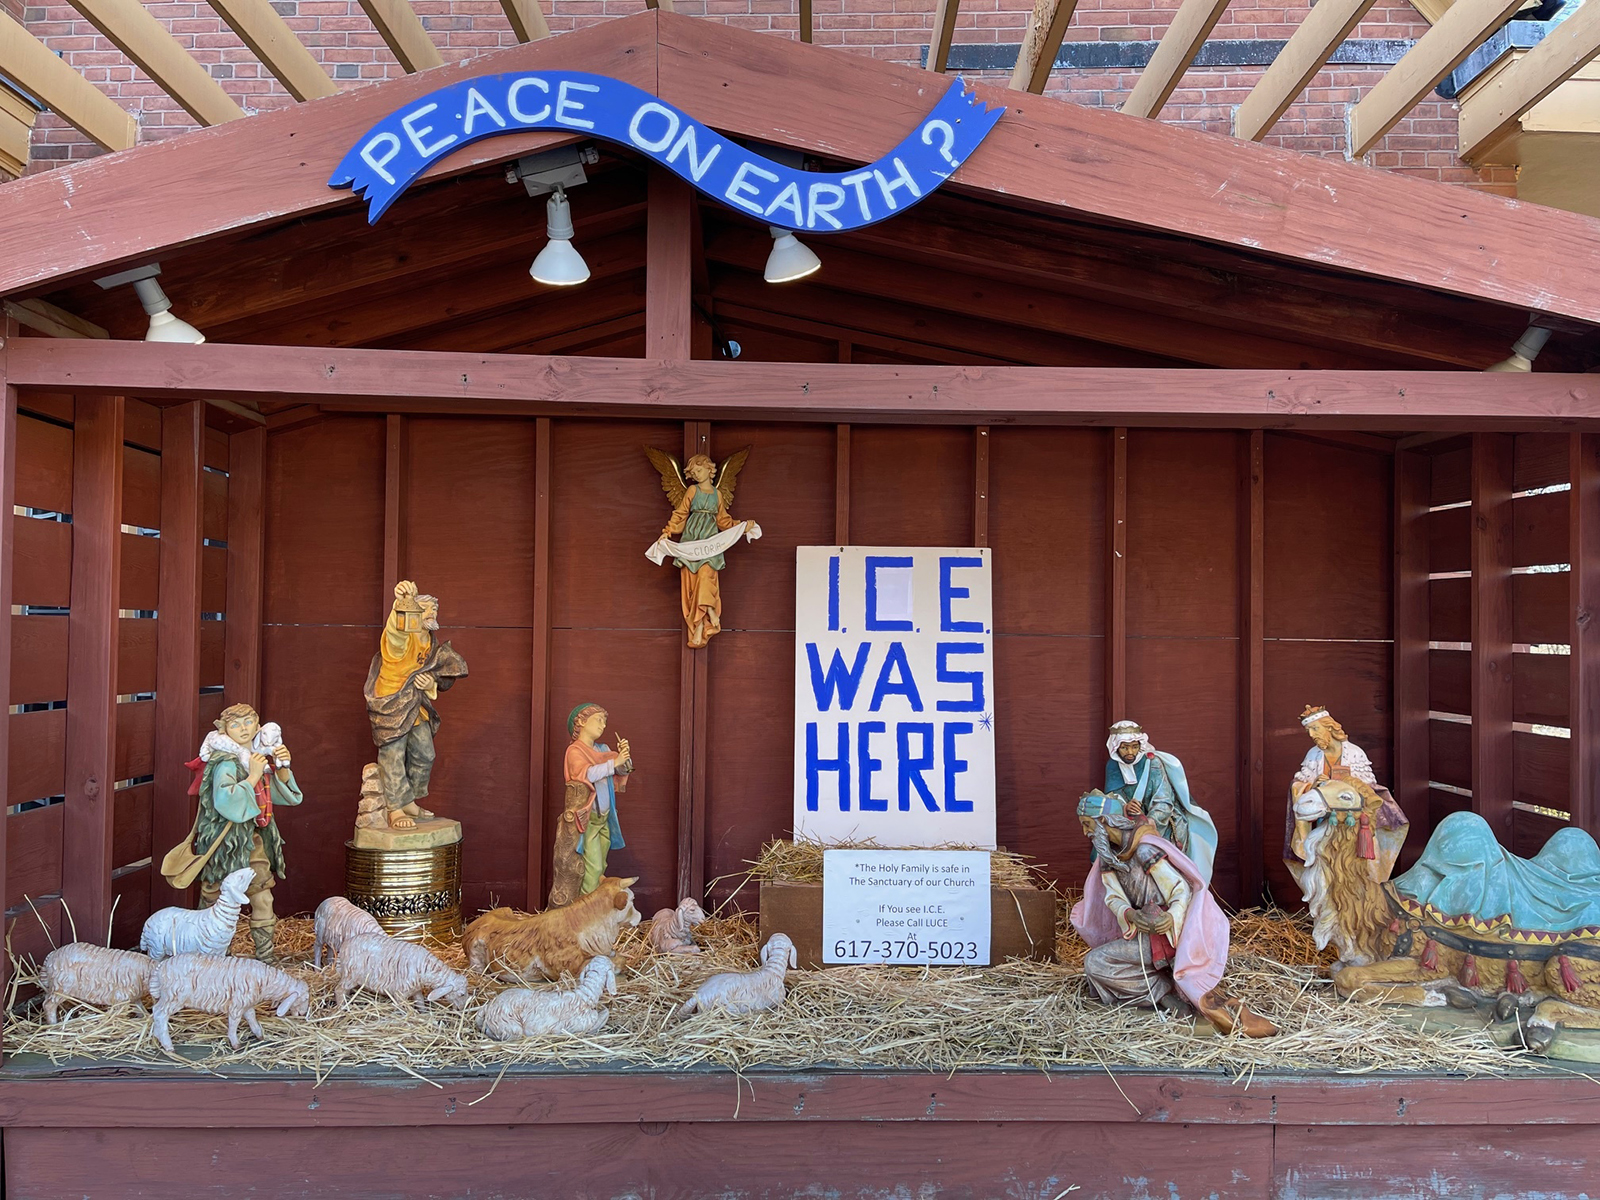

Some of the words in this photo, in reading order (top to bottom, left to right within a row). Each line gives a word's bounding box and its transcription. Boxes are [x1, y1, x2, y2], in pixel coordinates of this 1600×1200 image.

[359, 80, 600, 186] PEACE
[628, 102, 722, 183] ON
[724, 157, 922, 230] EARTH
[828, 556, 991, 634] I.C.E.
[805, 641, 985, 712] WAS
[878, 863, 899, 874] Holy
[901, 864, 930, 875] Family
[931, 864, 939, 873] is
[941, 864, 960, 873] safe
[961, 865, 970, 873] in
[849, 877, 866, 886] The
[868, 878, 912, 888] Sanctuary
[914, 877, 925, 886] of
[926, 879, 941, 887] our
[943, 878, 975, 887] Church
[878, 904, 886, 913] If
[887, 905, 903, 914] You
[923, 905, 945, 914] I.C.E.
[876, 918, 904, 927] Please
[907, 918, 923, 927] Call
[925, 918, 948, 928] LUCE
[907, 932, 917, 941] At
[834, 940, 978, 959] 617-370-5023
